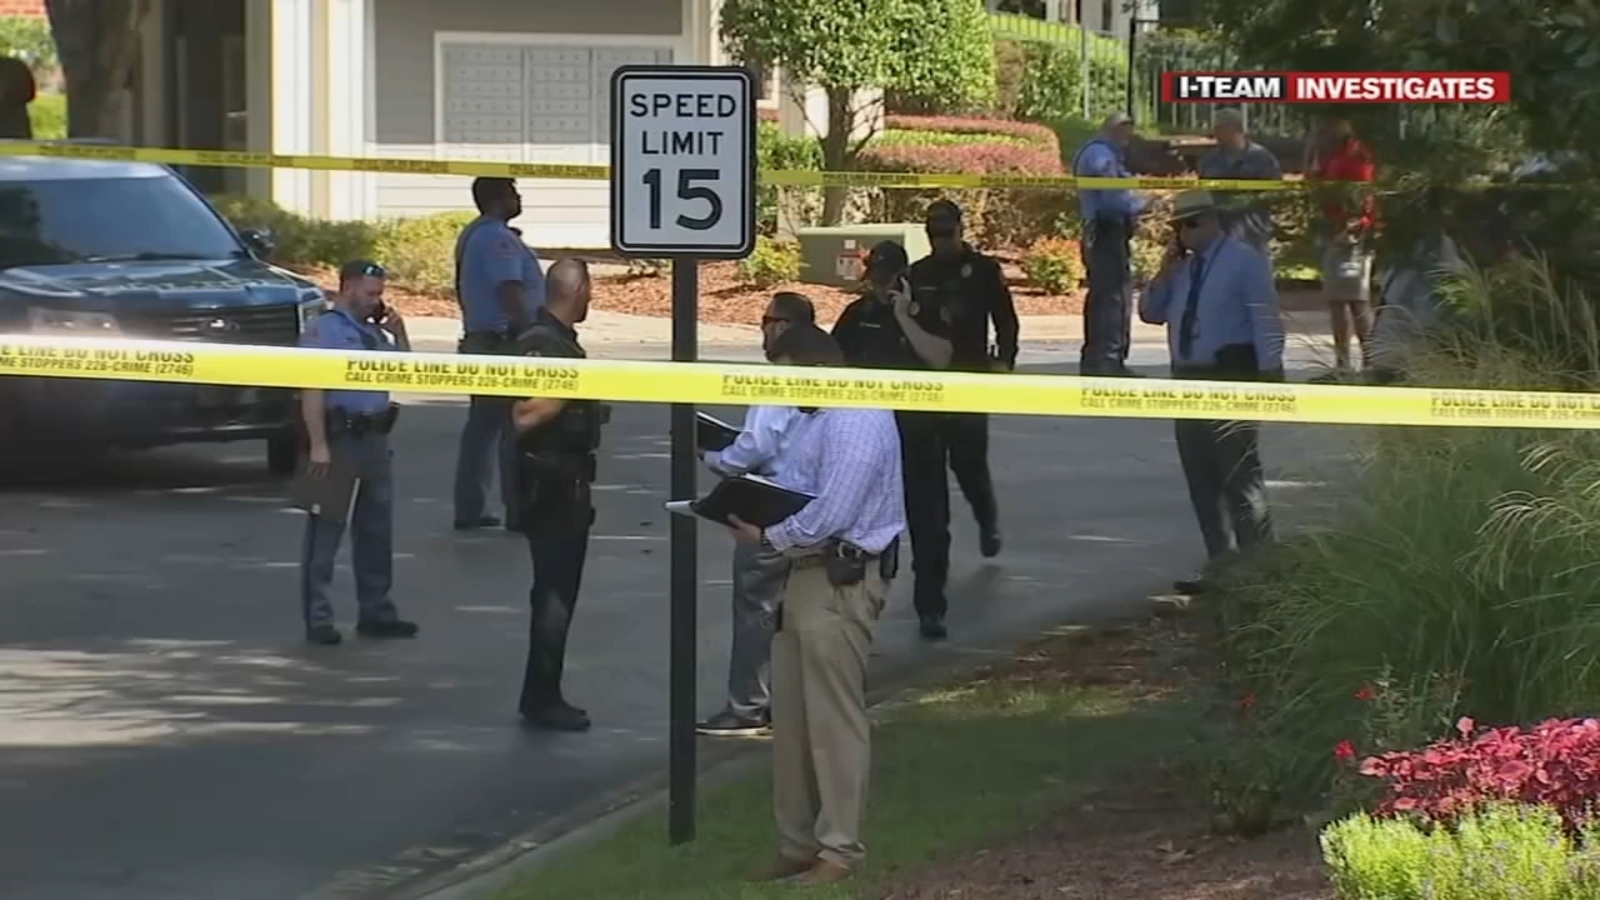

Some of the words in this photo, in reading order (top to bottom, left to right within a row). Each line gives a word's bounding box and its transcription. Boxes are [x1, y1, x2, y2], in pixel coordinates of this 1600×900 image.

[630, 93, 736, 118] SPEED
[642, 131, 724, 155] LIMIT
[642, 169, 723, 230] 15
[20, 357, 81, 370] STOPPERS
[347, 357, 408, 372] POLICE
[414, 359, 450, 374] LINE
[345, 371, 372, 383] CALL
[376, 372, 413, 385] CRIME
[416, 374, 474, 387] STOPPERS
